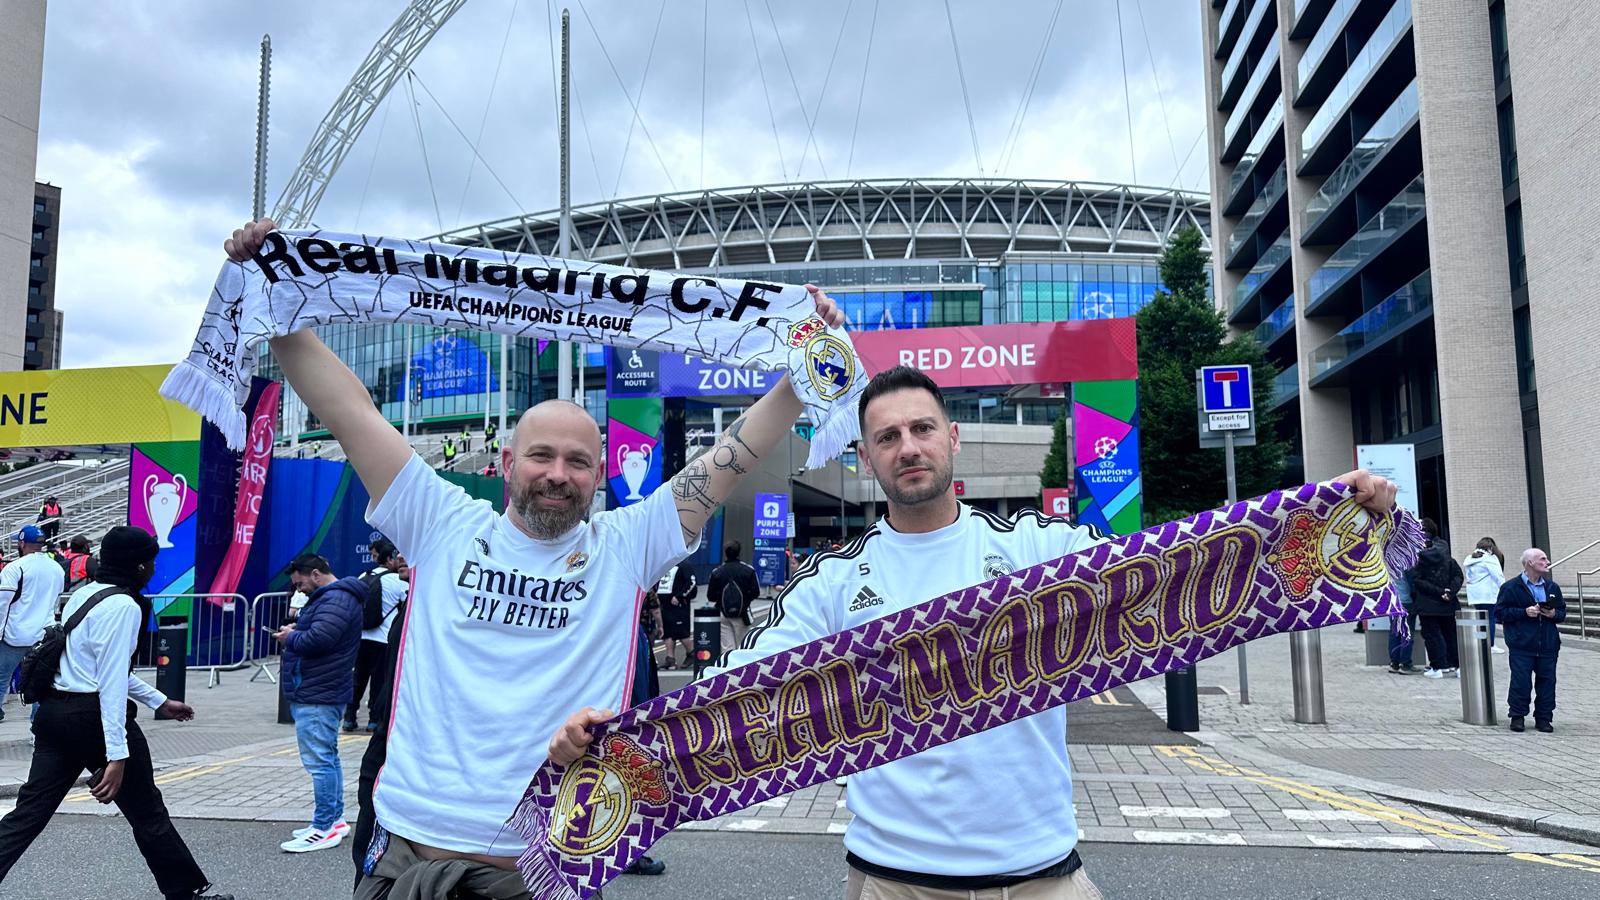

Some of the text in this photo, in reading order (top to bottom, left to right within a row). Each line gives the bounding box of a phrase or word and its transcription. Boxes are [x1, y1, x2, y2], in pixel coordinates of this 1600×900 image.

[251, 232, 399, 284] Real
[409, 291, 634, 333] UEFA CHAMPIONS LEAGUE
[899, 344, 1036, 371] RED ZONE
[423, 367, 473, 381] HAMPIONS
[616, 371, 655, 380] ACCESSIBLE
[699, 368, 765, 390] ZONE
[624, 379, 647, 387] ROUTE
[1082, 468, 1133, 477] CHAMPIONS
[756, 520, 785, 528] PURPLE
[760, 528, 780, 536] ZONE
[858, 562, 871, 576] 5
[457, 559, 588, 603] Emirates
[467, 595, 569, 629] FLY BETTER
[849, 596, 884, 612] adidas
[654, 526, 1262, 795] REAL MADRID
